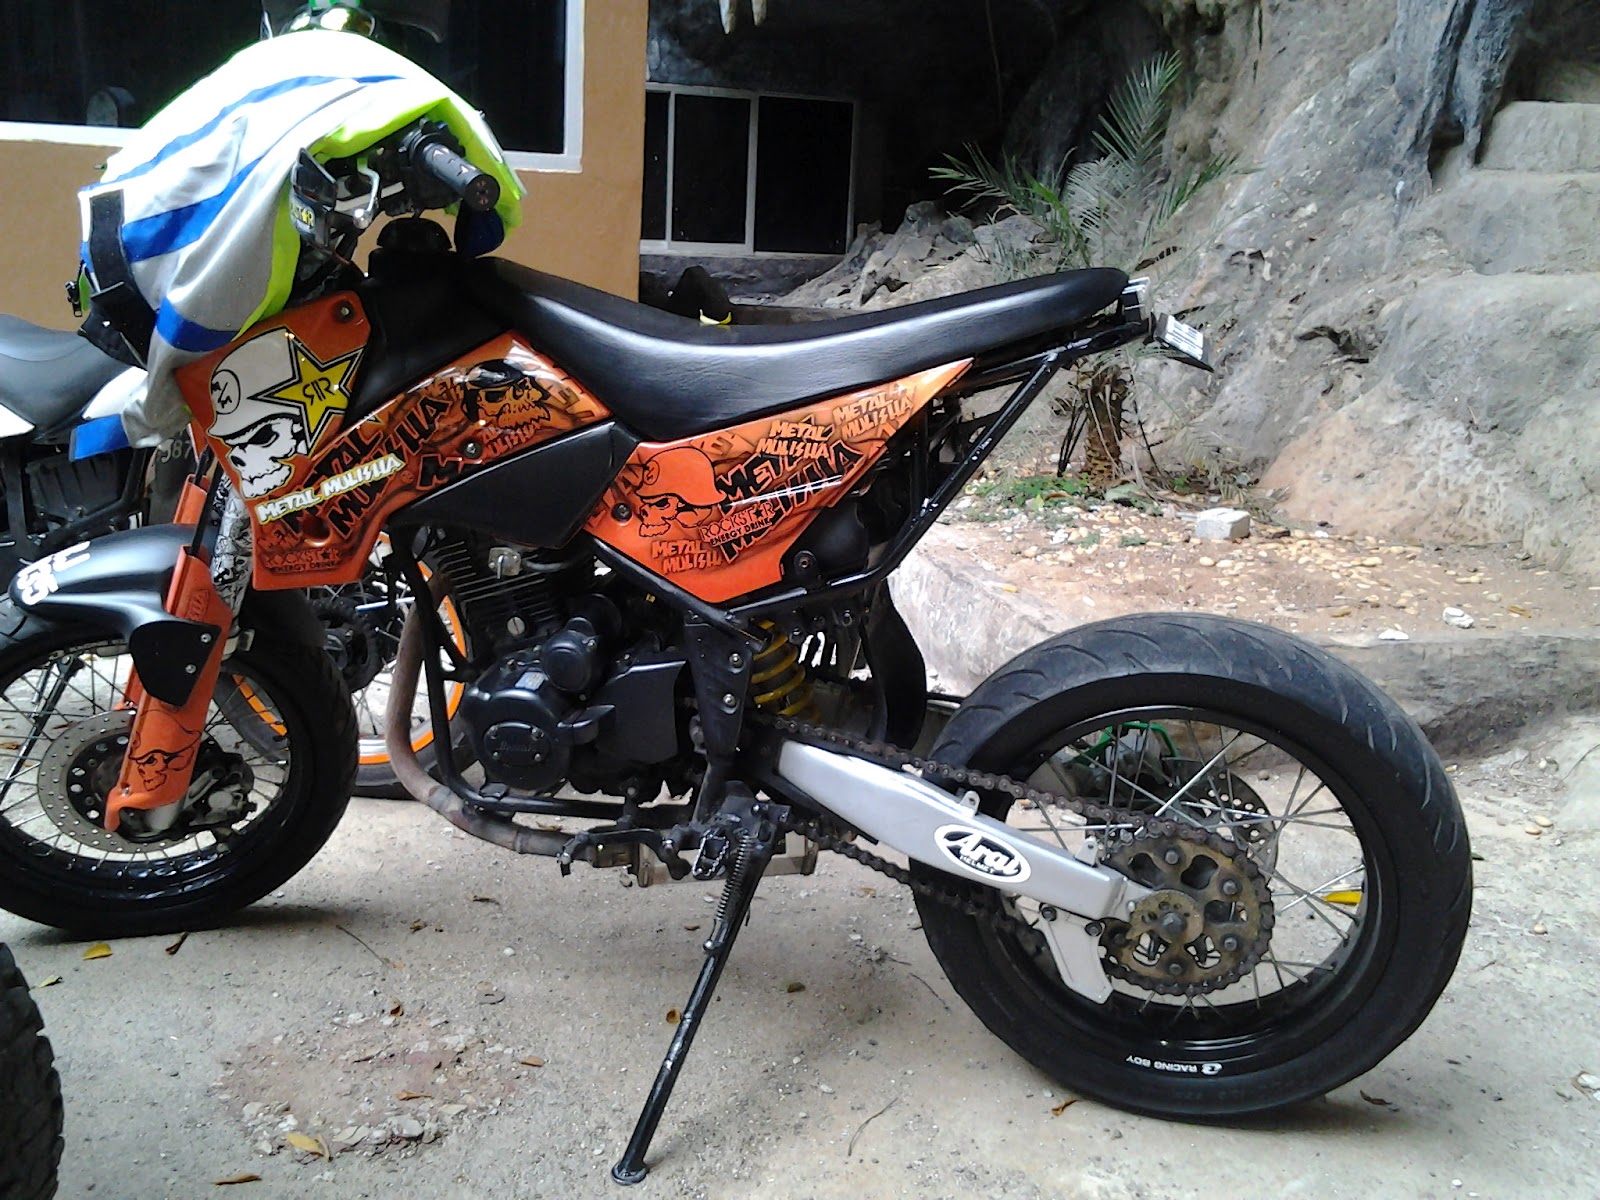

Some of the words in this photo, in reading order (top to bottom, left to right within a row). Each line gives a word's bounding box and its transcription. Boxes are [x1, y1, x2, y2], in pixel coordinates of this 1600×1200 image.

[832, 393, 893, 425] METAL
[842, 396, 914, 439] MULISHA
[769, 420, 829, 442] METAL
[756, 438, 830, 460] MULISHA
[255, 488, 322, 524] METAL
[320, 453, 405, 500] MULISHA
[710, 526, 745, 545] ENERGY
[745, 518, 772, 534] DRINK
[942, 830, 1021, 876] Arai
[1125, 1055, 1151, 1068] BOY
[1153, 1061, 1198, 1073] RACING
